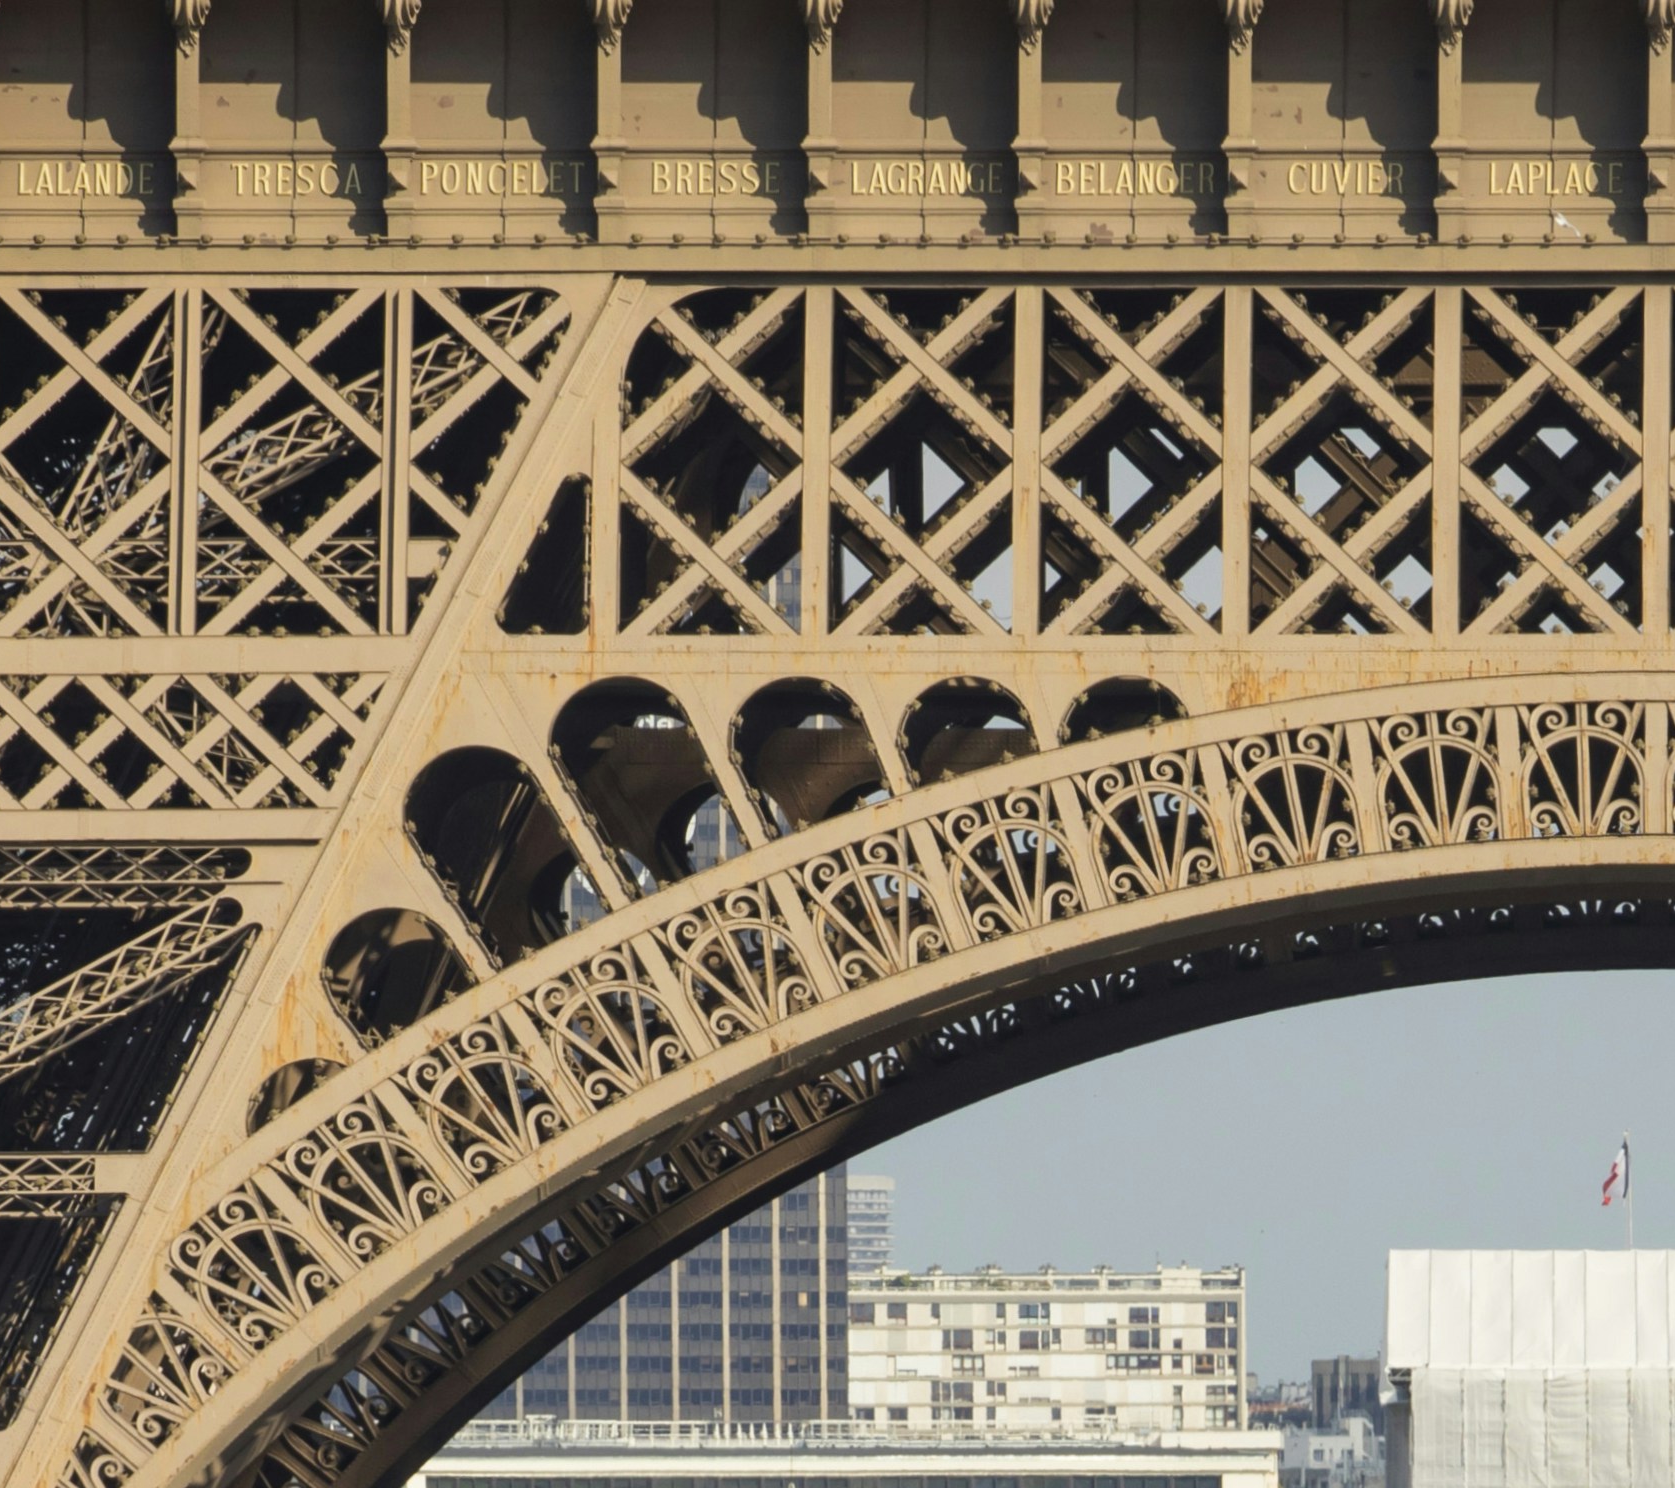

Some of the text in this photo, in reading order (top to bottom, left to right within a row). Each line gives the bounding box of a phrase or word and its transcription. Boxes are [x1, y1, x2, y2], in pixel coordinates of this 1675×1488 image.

[19, 162, 154, 194] LALANDE
[231, 162, 361, 195] TRESCA
[421, 162, 585, 195] PONCELET
[652, 162, 780, 194] BRESSE
[852, 162, 1003, 194] LAGRANGE
[1056, 162, 1214, 194] BELANGER
[1288, 161, 1403, 195] CUVIER
[1490, 161, 1623, 195] LAPLACE
